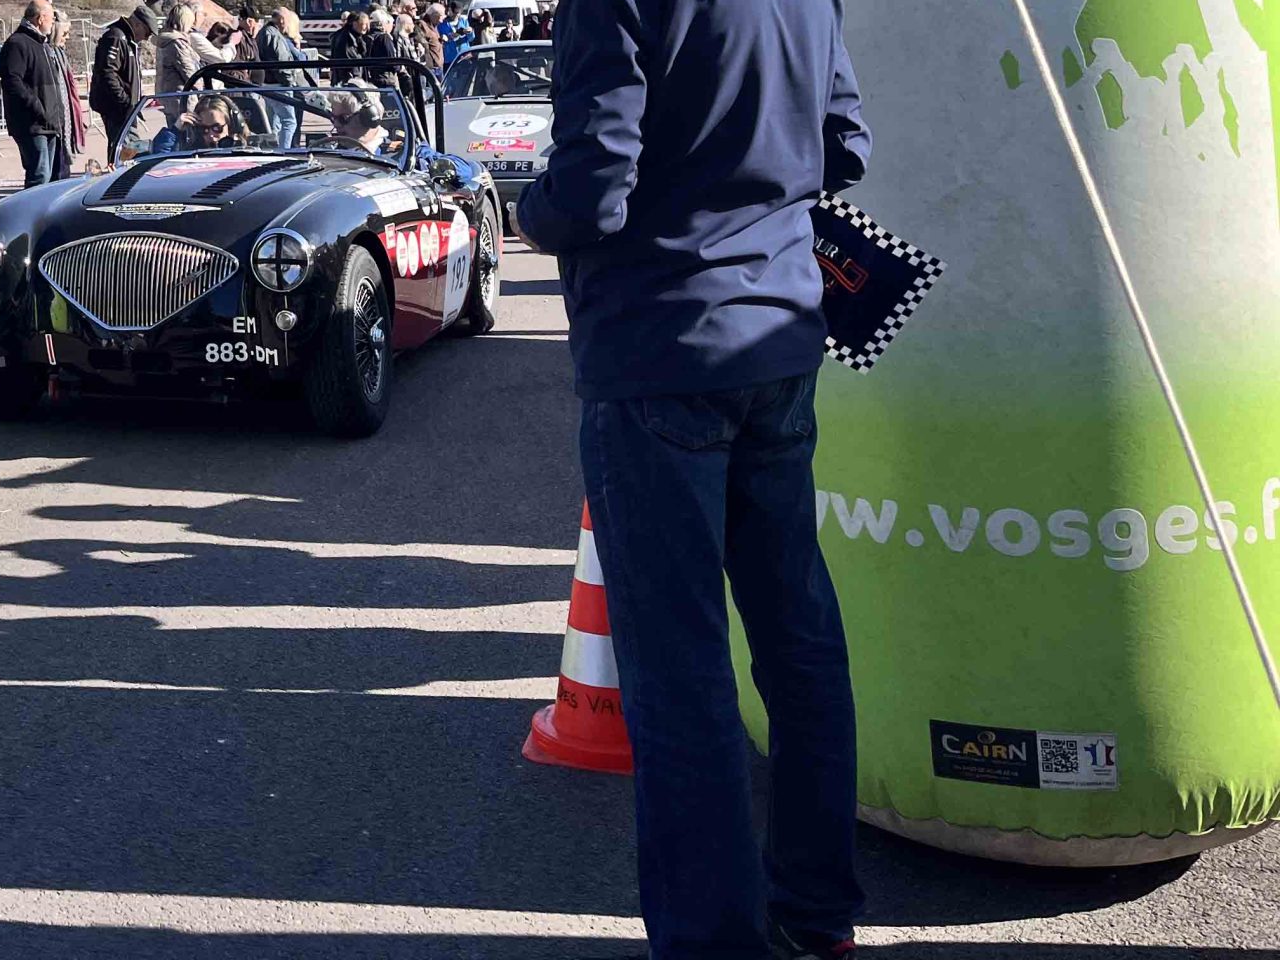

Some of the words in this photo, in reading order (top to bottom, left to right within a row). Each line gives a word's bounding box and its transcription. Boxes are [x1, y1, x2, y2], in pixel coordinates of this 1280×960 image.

[489, 120, 531, 128] 193
[515, 161, 529, 171] PE
[450, 255, 466, 293] 192
[233, 316, 257, 334] EM
